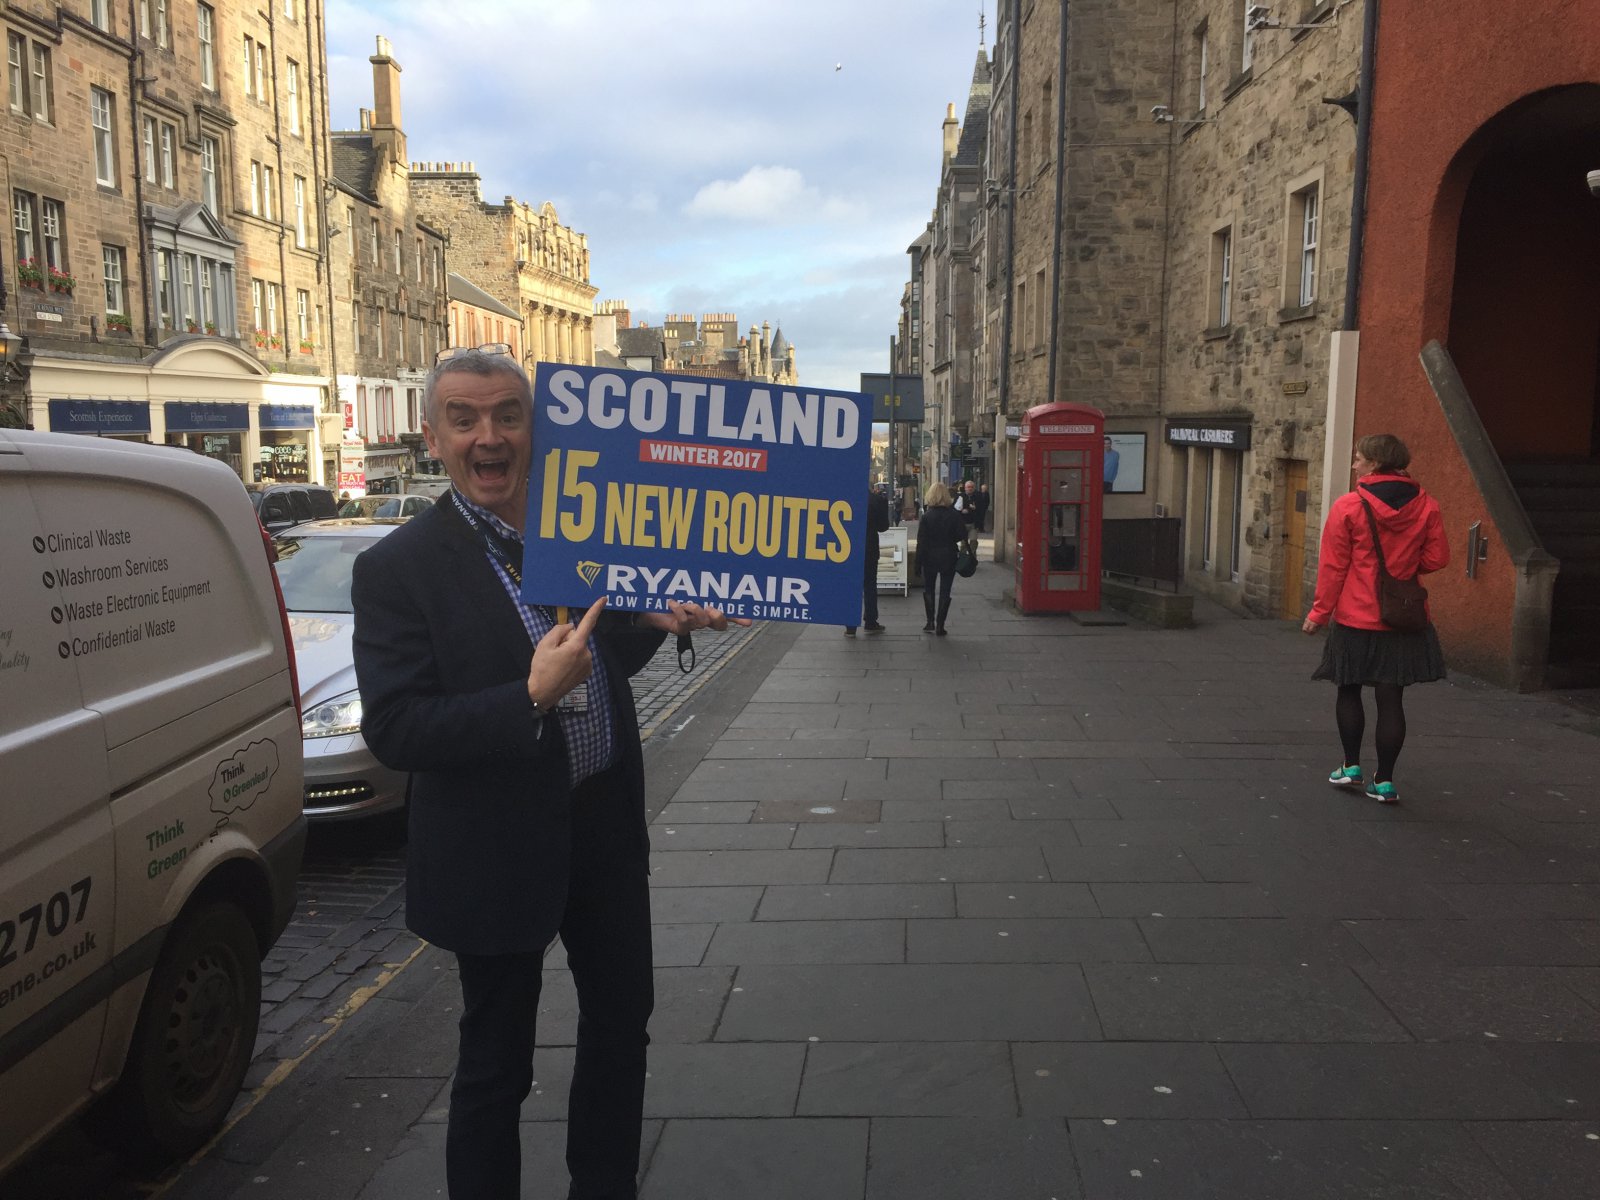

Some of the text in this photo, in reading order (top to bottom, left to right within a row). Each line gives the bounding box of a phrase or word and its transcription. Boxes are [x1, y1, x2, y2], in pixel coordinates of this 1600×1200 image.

[69, 410, 133, 426] Scottish Experience
[546, 369, 859, 450] SCOTLAND
[1043, 425, 1092, 433] TELEPHONE
[650, 443, 762, 470] WINTER 2017
[341, 473, 362, 482] EAT
[539, 448, 853, 563] 15 NEW ROUTES
[47, 529, 131, 553] Clinical Waste
[56, 557, 169, 588] Washroom Services
[606, 564, 811, 605] RYANAIR
[64, 579, 211, 622] Waste Electronic Equipment
[606, 594, 638, 607] LOW
[752, 604, 813, 621] SIMPLE.
[72, 618, 176, 657] Confidential Waste
[221, 761, 246, 784] Think
[232, 765, 269, 798] Greenleaf
[146, 819, 184, 851] Think
